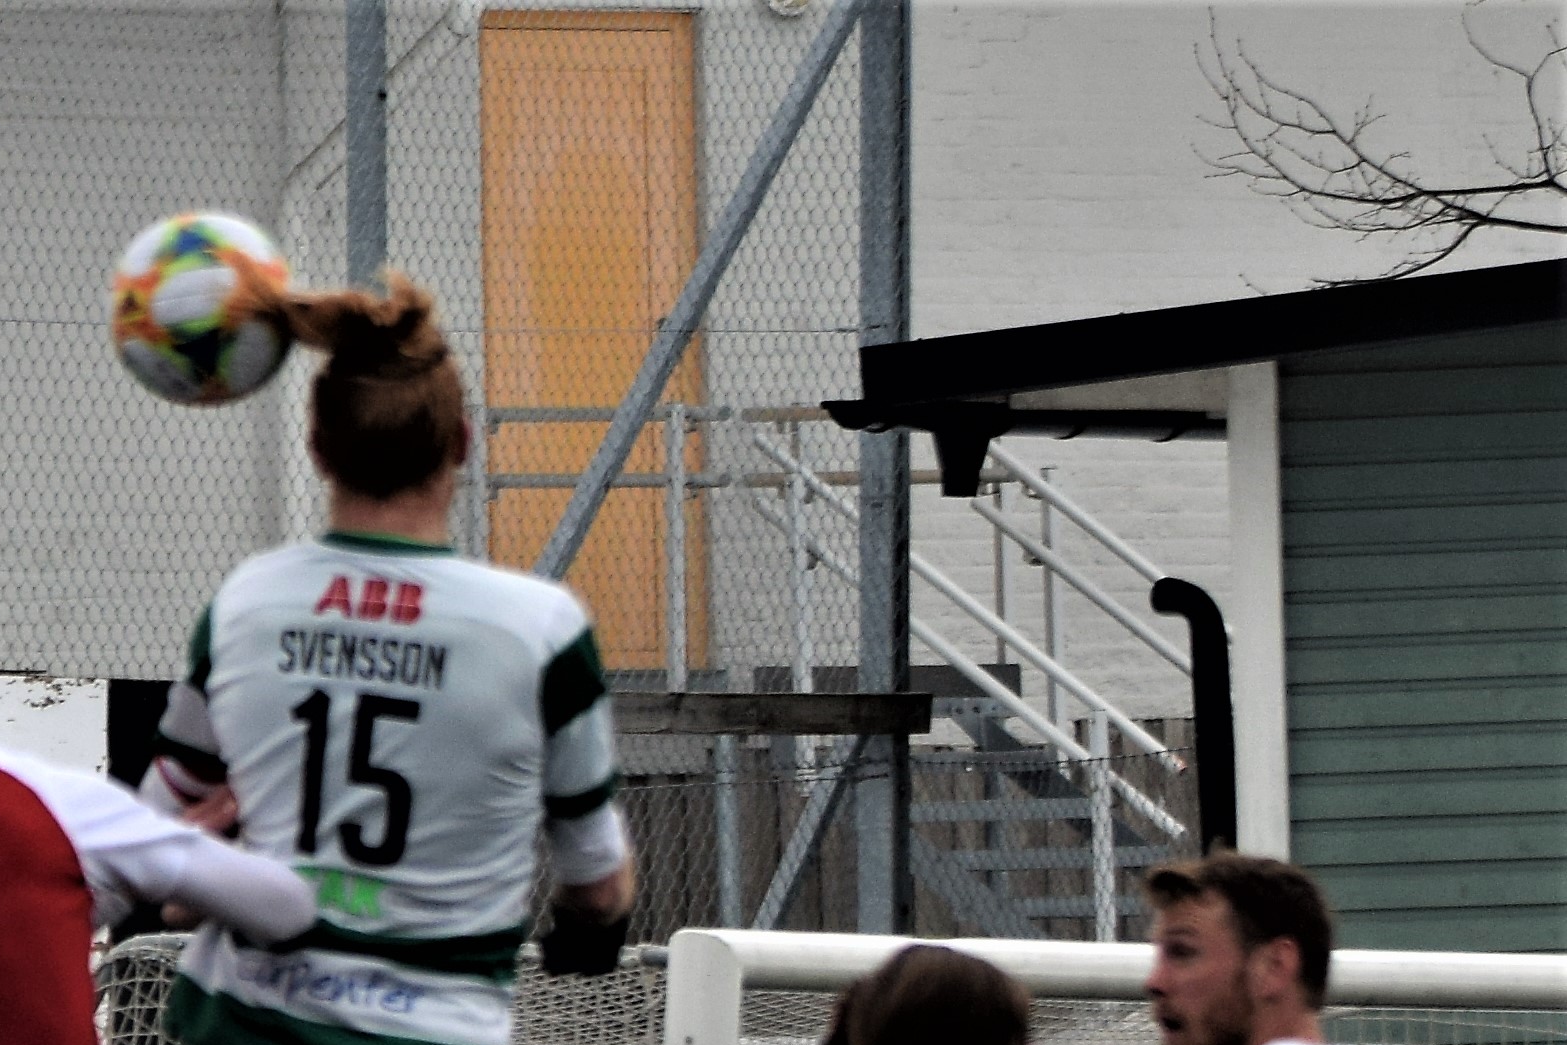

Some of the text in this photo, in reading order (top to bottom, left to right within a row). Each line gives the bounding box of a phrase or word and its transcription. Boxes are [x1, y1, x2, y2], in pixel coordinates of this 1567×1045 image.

[314, 575, 426, 626] ABB
[276, 629, 448, 692] SVENSSON
[289, 687, 421, 868] 15
